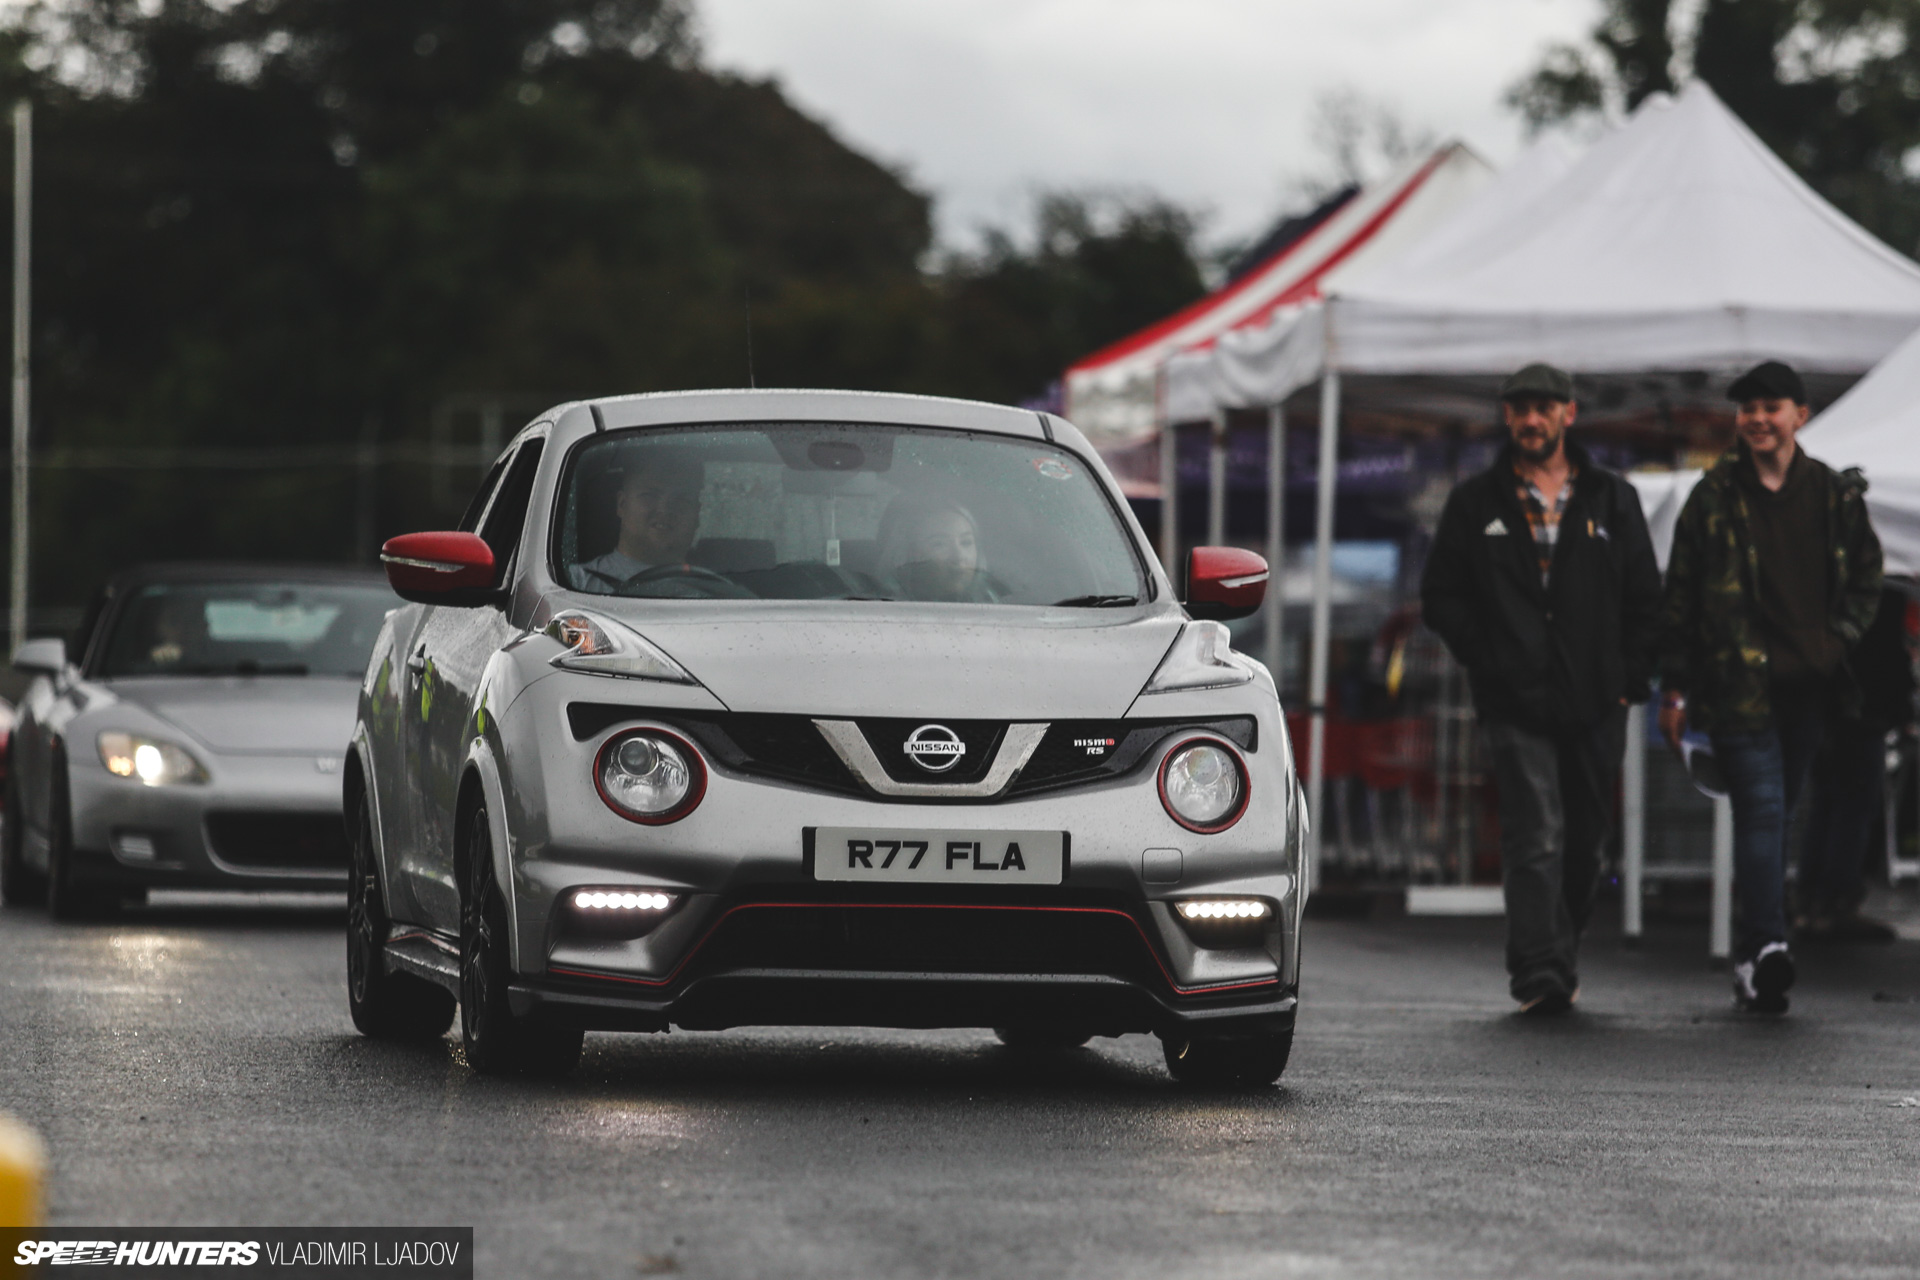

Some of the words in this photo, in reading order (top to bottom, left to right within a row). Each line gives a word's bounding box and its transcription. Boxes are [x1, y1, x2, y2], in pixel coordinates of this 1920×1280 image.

[911, 743, 960, 752] NISSAN
[1086, 746, 1105, 755] RS
[847, 839, 929, 869] R77
[945, 841, 1026, 871] FLA
